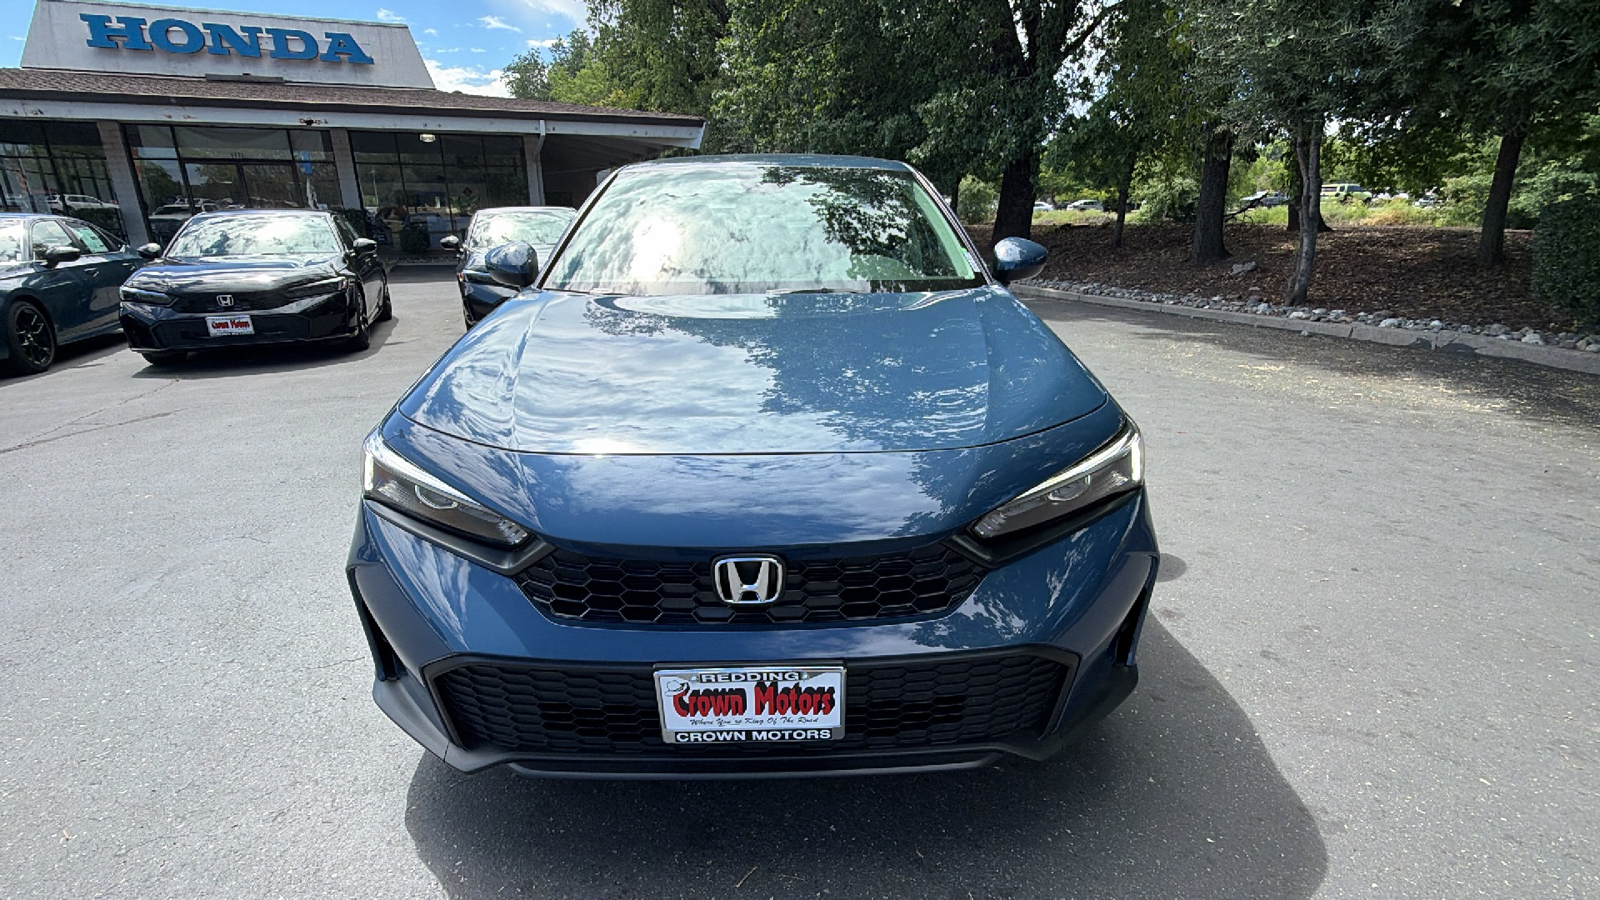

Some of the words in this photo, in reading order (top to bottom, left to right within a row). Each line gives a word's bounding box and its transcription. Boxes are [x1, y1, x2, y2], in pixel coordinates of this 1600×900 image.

[79, 13, 374, 65] HONDA
[722, 559, 776, 603] H
[701, 672, 800, 683] REDDING
[673, 682, 747, 717] Crown
[754, 681, 836, 716] Motors
[744, 717, 764, 725] King
[767, 716, 778, 725] Of
[780, 716, 794, 724] The
[796, 716, 819, 724] Road
[676, 731, 746, 742] CROWN
[752, 729, 831, 741] MOTORS
